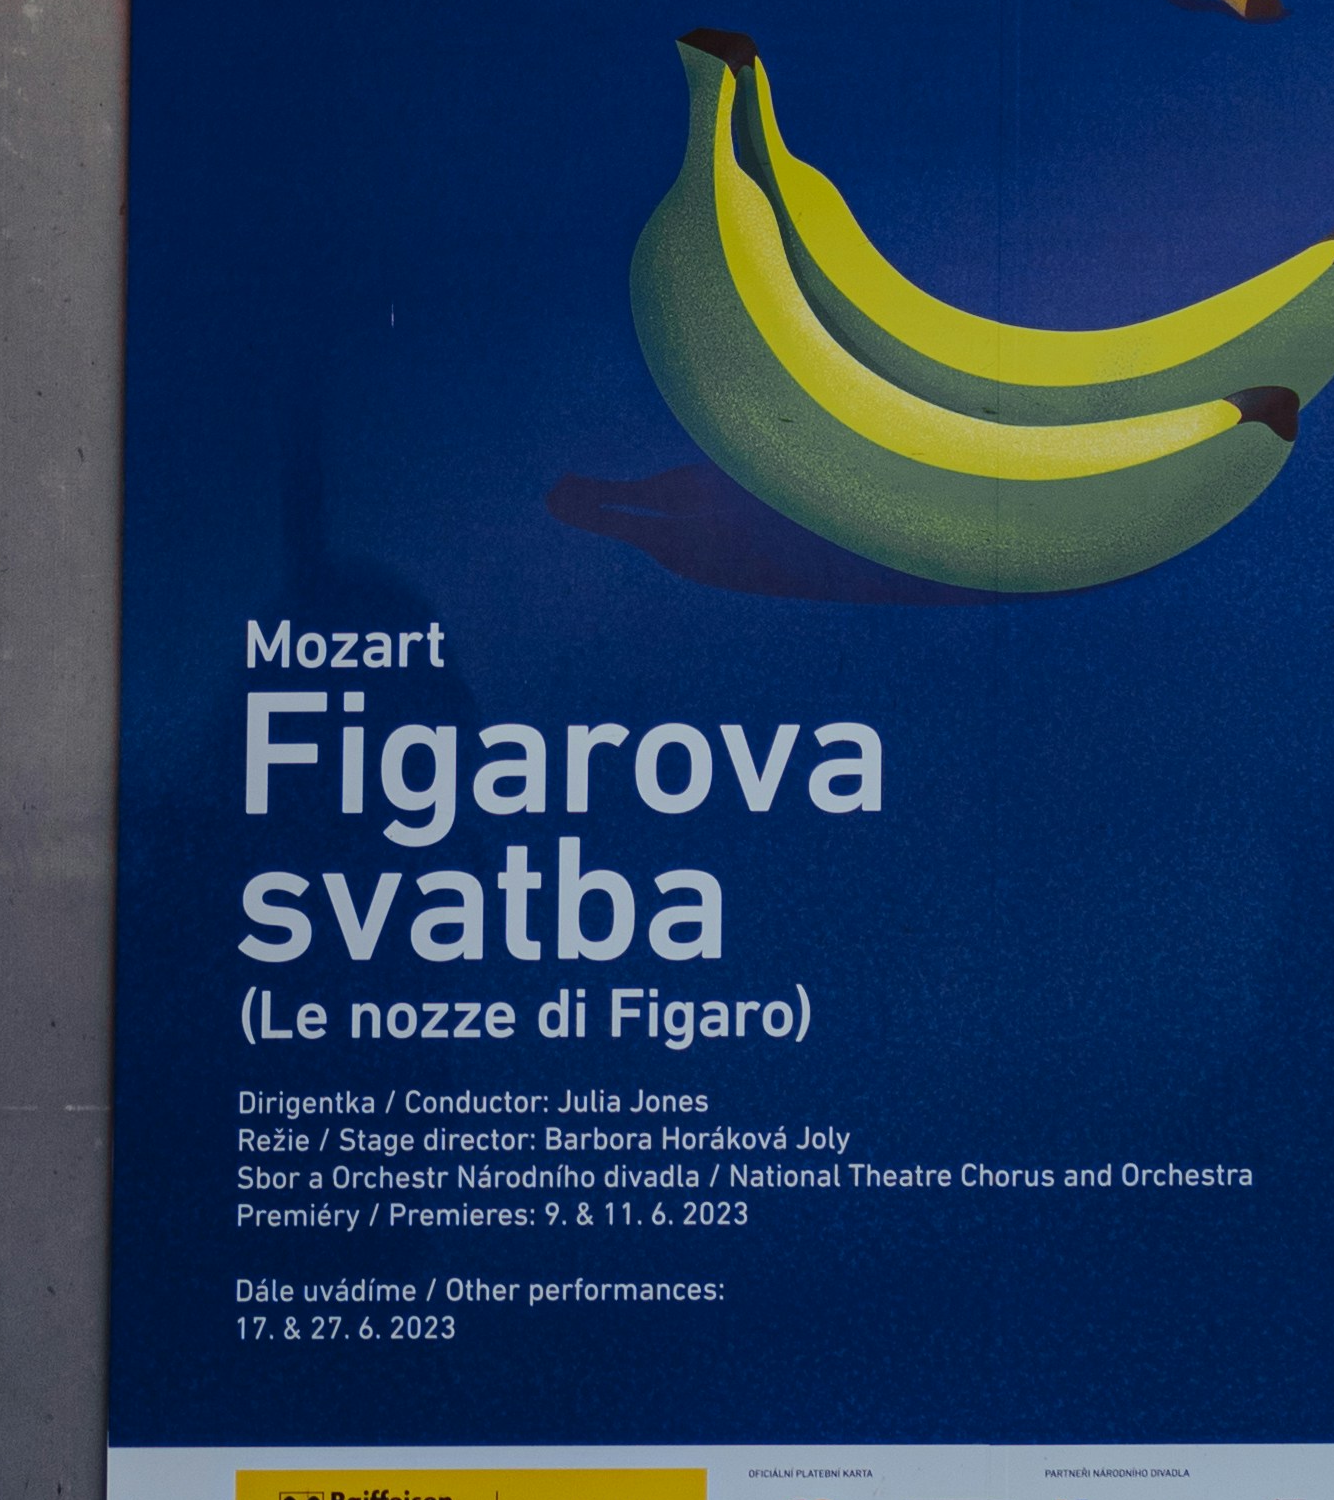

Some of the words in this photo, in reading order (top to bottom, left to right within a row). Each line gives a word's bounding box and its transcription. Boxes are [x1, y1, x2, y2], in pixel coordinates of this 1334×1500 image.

[247, 620, 444, 668] Mozart
[246, 692, 882, 848] Figarova
[238, 836, 722, 962] svatba
[242, 986, 327, 1044] (Le
[352, 1002, 515, 1038] nozze
[538, 989, 585, 1038] di
[612, 984, 810, 1050] Figaro)
[239, 1091, 374, 1119] Dirigentka
[385, 1090, 395, 1113] /
[406, 1090, 548, 1113] Conductor:
[558, 1089, 620, 1113] Julia
[630, 1089, 708, 1112] Jones
[239, 1128, 309, 1151] Režie
[320, 1128, 329, 1151] /
[340, 1128, 414, 1156] Stage
[424, 1128, 535, 1151] director:
[546, 1127, 651, 1150] Barbora
[663, 1126, 786, 1150] Horáková
[796, 1126, 850, 1154] Joly
[238, 1166, 300, 1189] Sbor
[309, 1172, 322, 1189] a
[333, 1166, 448, 1189] Orchestr
[458, 1164, 595, 1188] Národního
[604, 1164, 699, 1188] divadla
[710, 1164, 720, 1187] /
[731, 1164, 840, 1187] National
[848, 1164, 951, 1187] Theatre
[961, 1163, 1054, 1187] Chorus
[1064, 1163, 1111, 1187] and
[1122, 1163, 1252, 1186] Orchestra
[238, 1203, 359, 1232] Premiéry
[369, 1203, 379, 1226] /
[390, 1203, 534, 1226] Premieres:
[545, 1202, 566, 1225] 9.
[577, 1202, 593, 1225] &
[606, 1202, 642, 1225] 11.
[652, 1202, 673, 1225] 6.
[683, 1201, 747, 1225] 2023
[237, 1278, 294, 1302] Dále
[304, 1278, 416, 1302] uvádíme
[426, 1278, 436, 1301] /
[447, 1278, 520, 1301] Other
[530, 1278, 724, 1306] performances:
[238, 1317, 273, 1339] 17.
[284, 1316, 301, 1340] &
[312, 1316, 349, 1339] 27.
[359, 1316, 380, 1339] 6.
[391, 1316, 455, 1339] 2023
[748, 1469, 794, 1479] OFICIÁLNÍ
[795, 1469, 841, 1479] PLATEBNÍ
[842, 1469, 874, 1478] KARTA
[1044, 1467, 1091, 1478] PARTNEŘI
[1092, 1468, 1149, 1478] NÁRODNÍHO
[1149, 1468, 1191, 1478] DIVADLA
